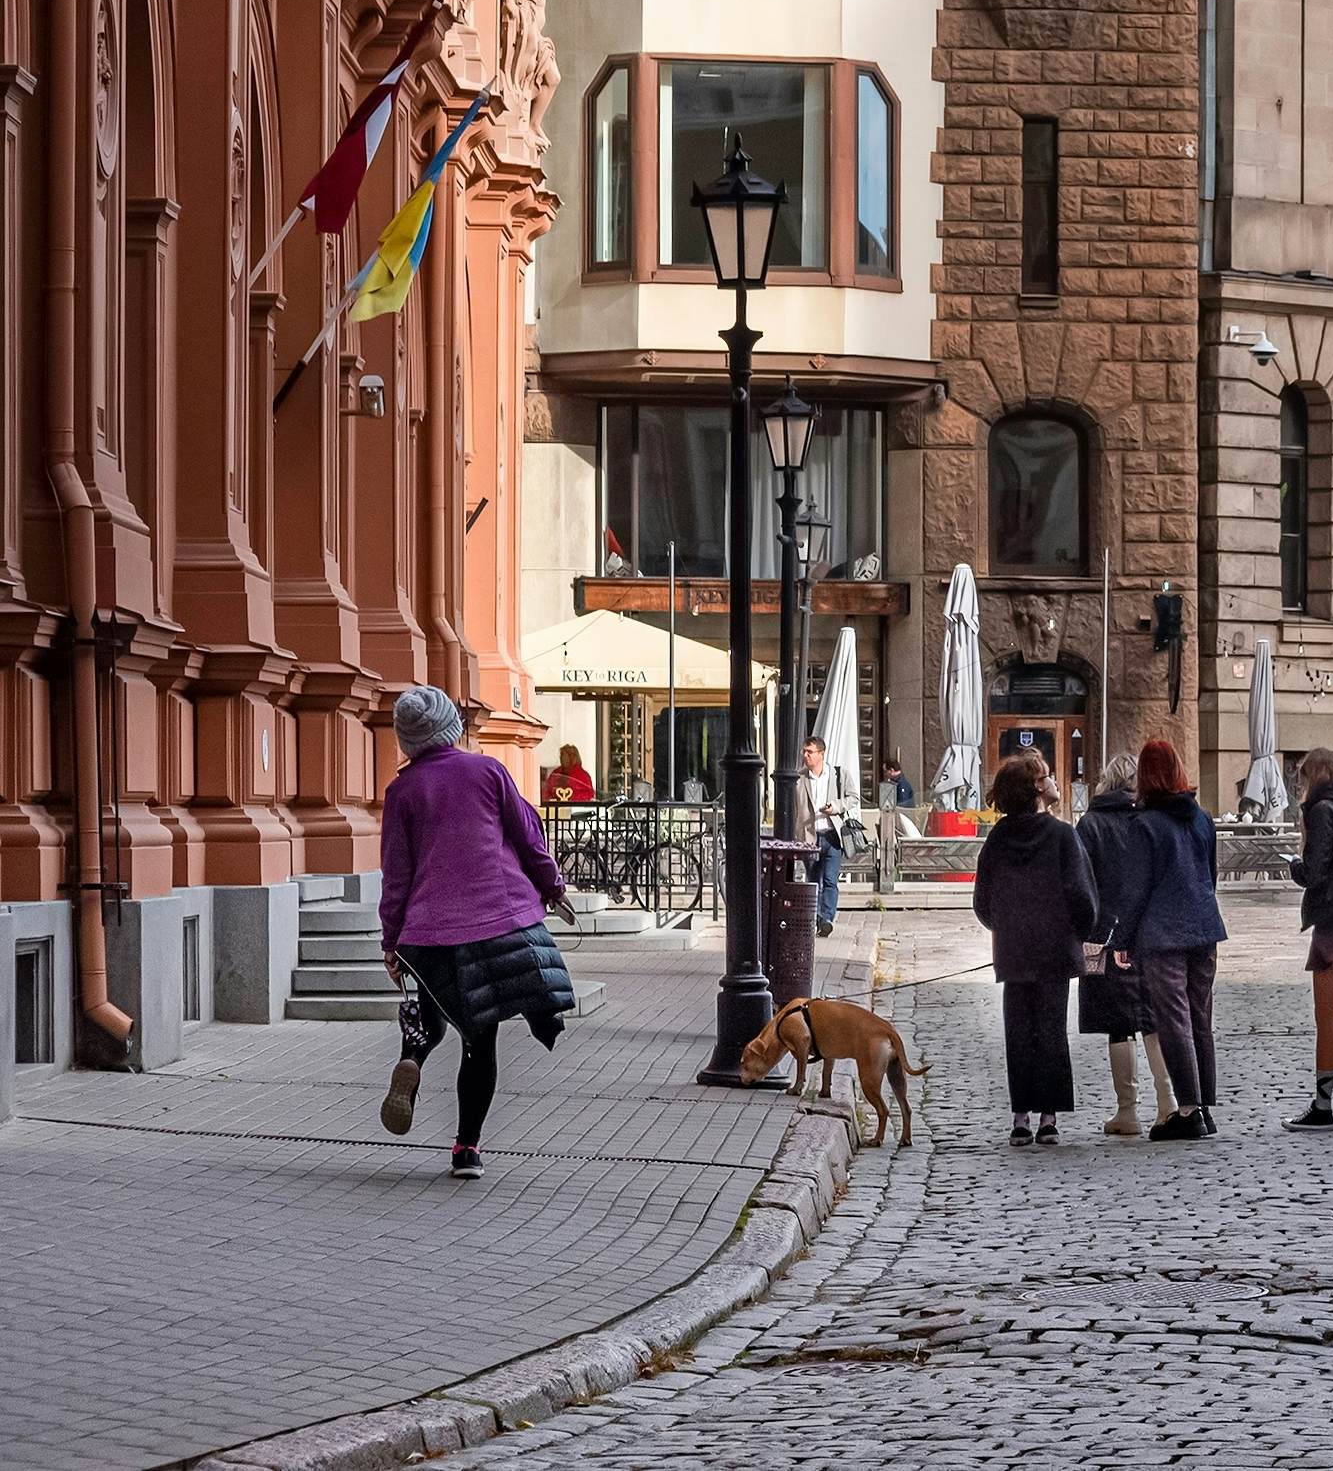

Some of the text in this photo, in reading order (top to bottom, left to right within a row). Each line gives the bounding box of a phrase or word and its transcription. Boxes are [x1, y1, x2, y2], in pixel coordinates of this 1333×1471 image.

[562, 669, 648, 683] KEY to RIGA
